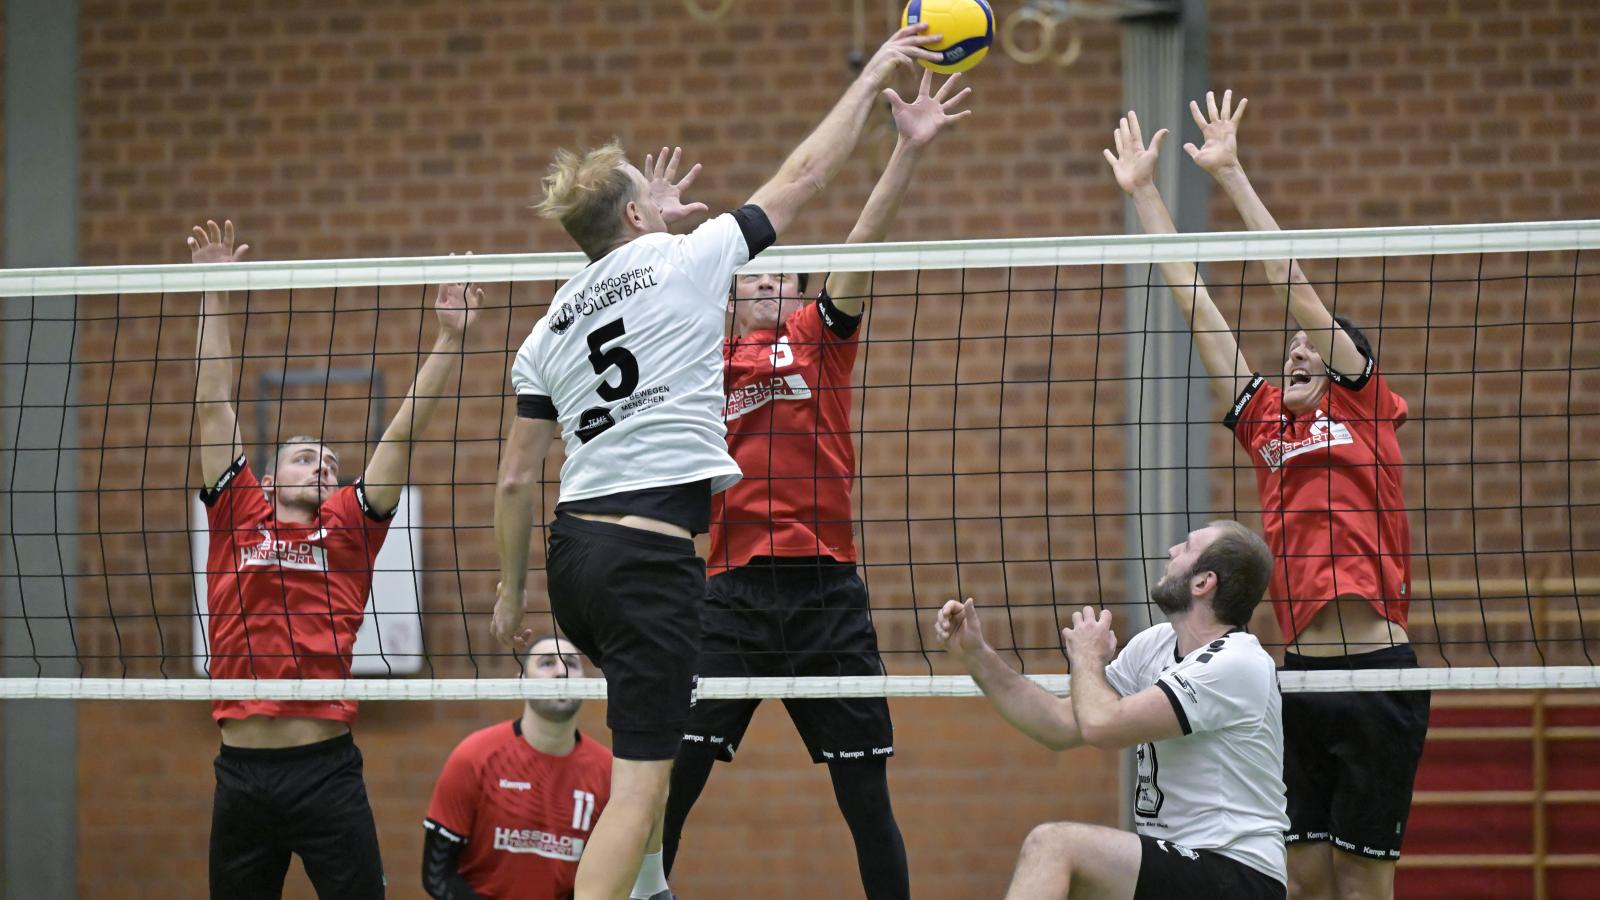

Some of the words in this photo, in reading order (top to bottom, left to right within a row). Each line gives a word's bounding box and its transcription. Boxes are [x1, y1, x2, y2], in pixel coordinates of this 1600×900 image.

[582, 275, 657, 316] OLLEYBALL
[587, 317, 640, 402] 5
[621, 396, 664, 411] MENSCHEN
[683, 734, 704, 743] empa
[839, 750, 865, 759] Kempa
[571, 789, 595, 832] 11
[493, 827, 573, 850] HASSOLD
[1335, 837, 1356, 851] Kempa
[1363, 846, 1386, 857] Kempa
